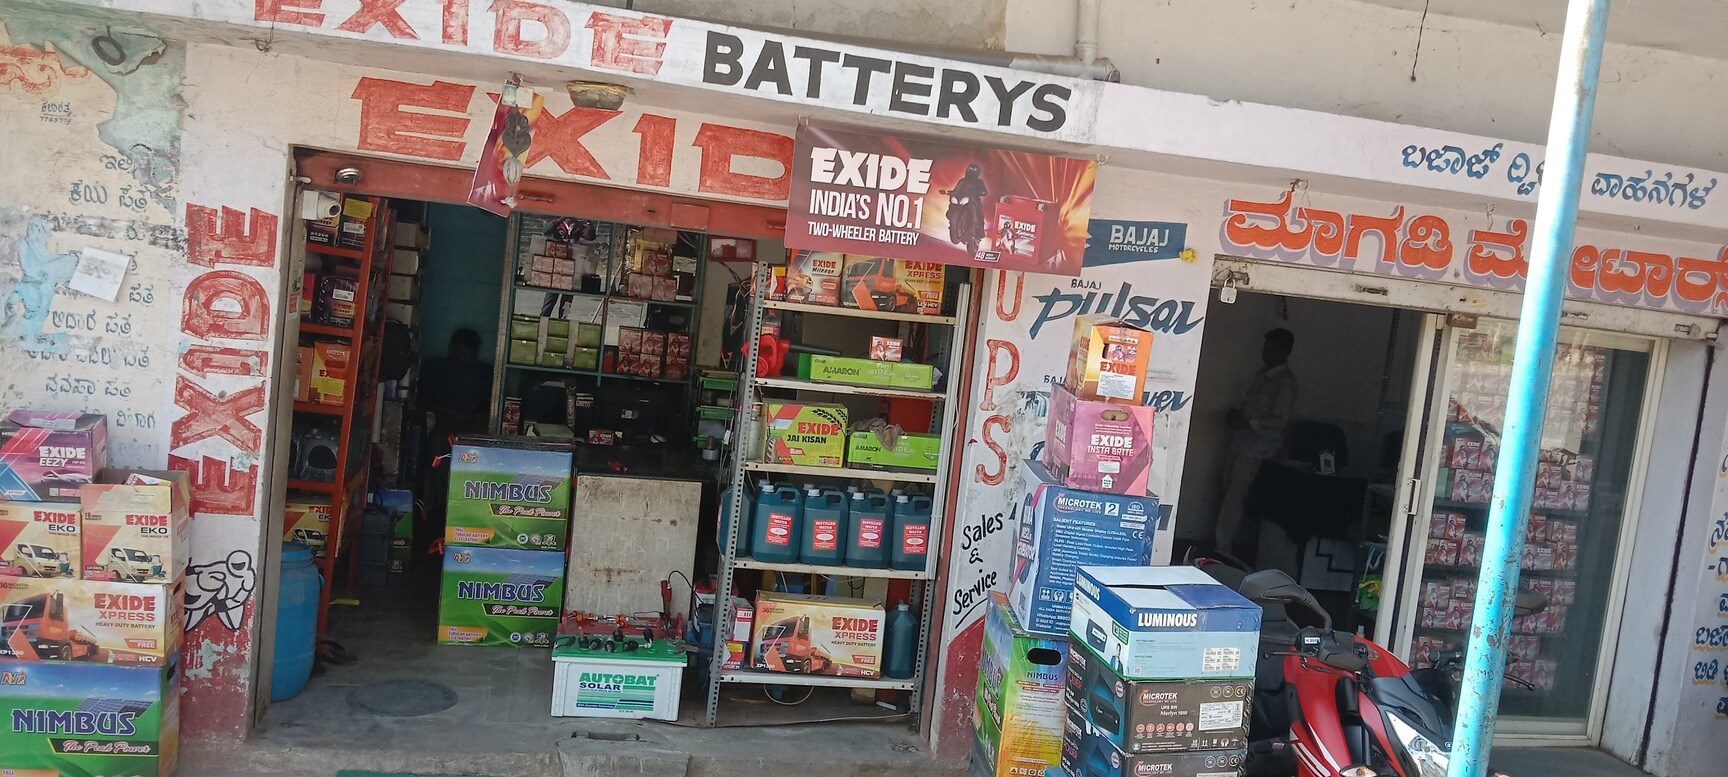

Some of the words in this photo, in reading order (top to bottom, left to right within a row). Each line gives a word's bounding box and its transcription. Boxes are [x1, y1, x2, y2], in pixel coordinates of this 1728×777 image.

[702, 30, 1072, 132] BATTERYS
[810, 146, 934, 195] EXIDE
[1401, 142, 1504, 180] ಬಜಾಜ್
[1591, 169, 1718, 210] ವಾಹನಗಳ
[809, 188, 872, 220] INDIA'S
[875, 192, 924, 230] NO.1
[807, 221, 877, 242] TWO-WHEELER
[878, 228, 920, 246] BATTERY
[1014, 220, 1037, 233] EXIDE
[1224, 187, 1454, 276] ಮಾಗಡಿ
[1109, 224, 1169, 248] BAJAJ
[1108, 243, 1159, 254] MOTORCYCLES
[812, 259, 837, 269] EXIDE
[907, 271, 941, 279] XPRESS
[1070, 278, 1102, 291] BAJAJ
[166, 200, 280, 519] EXIDE
[1099, 361, 1137, 375] EXIDE
[798, 421, 839, 436] EXIDE
[787, 434, 800, 442] JAI
[801, 435, 827, 444] KISAN
[1091, 434, 1134, 449] EXIDE
[39, 446, 86, 459] EXIDE
[1087, 446, 1110, 454] INSTA
[40, 458, 68, 467] EEZY
[464, 481, 553, 504] NIMBUS
[1058, 497, 1102, 510] MICROTEK
[34, 511, 76, 525] EXIDE
[125, 513, 168, 527] EXIDE
[48, 524, 76, 532] EKO
[961, 512, 1003, 551] Sales
[969, 547, 984, 565] &
[457, 580, 545, 602] NIMBUS
[952, 568, 997, 616] Service
[1076, 571, 1100, 601] LUMINOUS
[94, 593, 156, 611] EXIDE
[99, 611, 155, 621] XPRESS
[1137, 613, 1198, 628] LUMINOUS
[832, 616, 879, 632] EXIDE
[834, 631, 877, 641] XPRESS
[579, 672, 657, 686] AUTOBAT
[1026, 671, 1058, 681] NIMBUS
[579, 682, 621, 691] SOLAR
[1142, 692, 1178, 700] MICROTEK
[11, 708, 136, 736] NIMBUS
[62, 739, 84, 753] The
[114, 740, 151, 754] Power
[1137, 763, 1173, 772] MICROTEK
